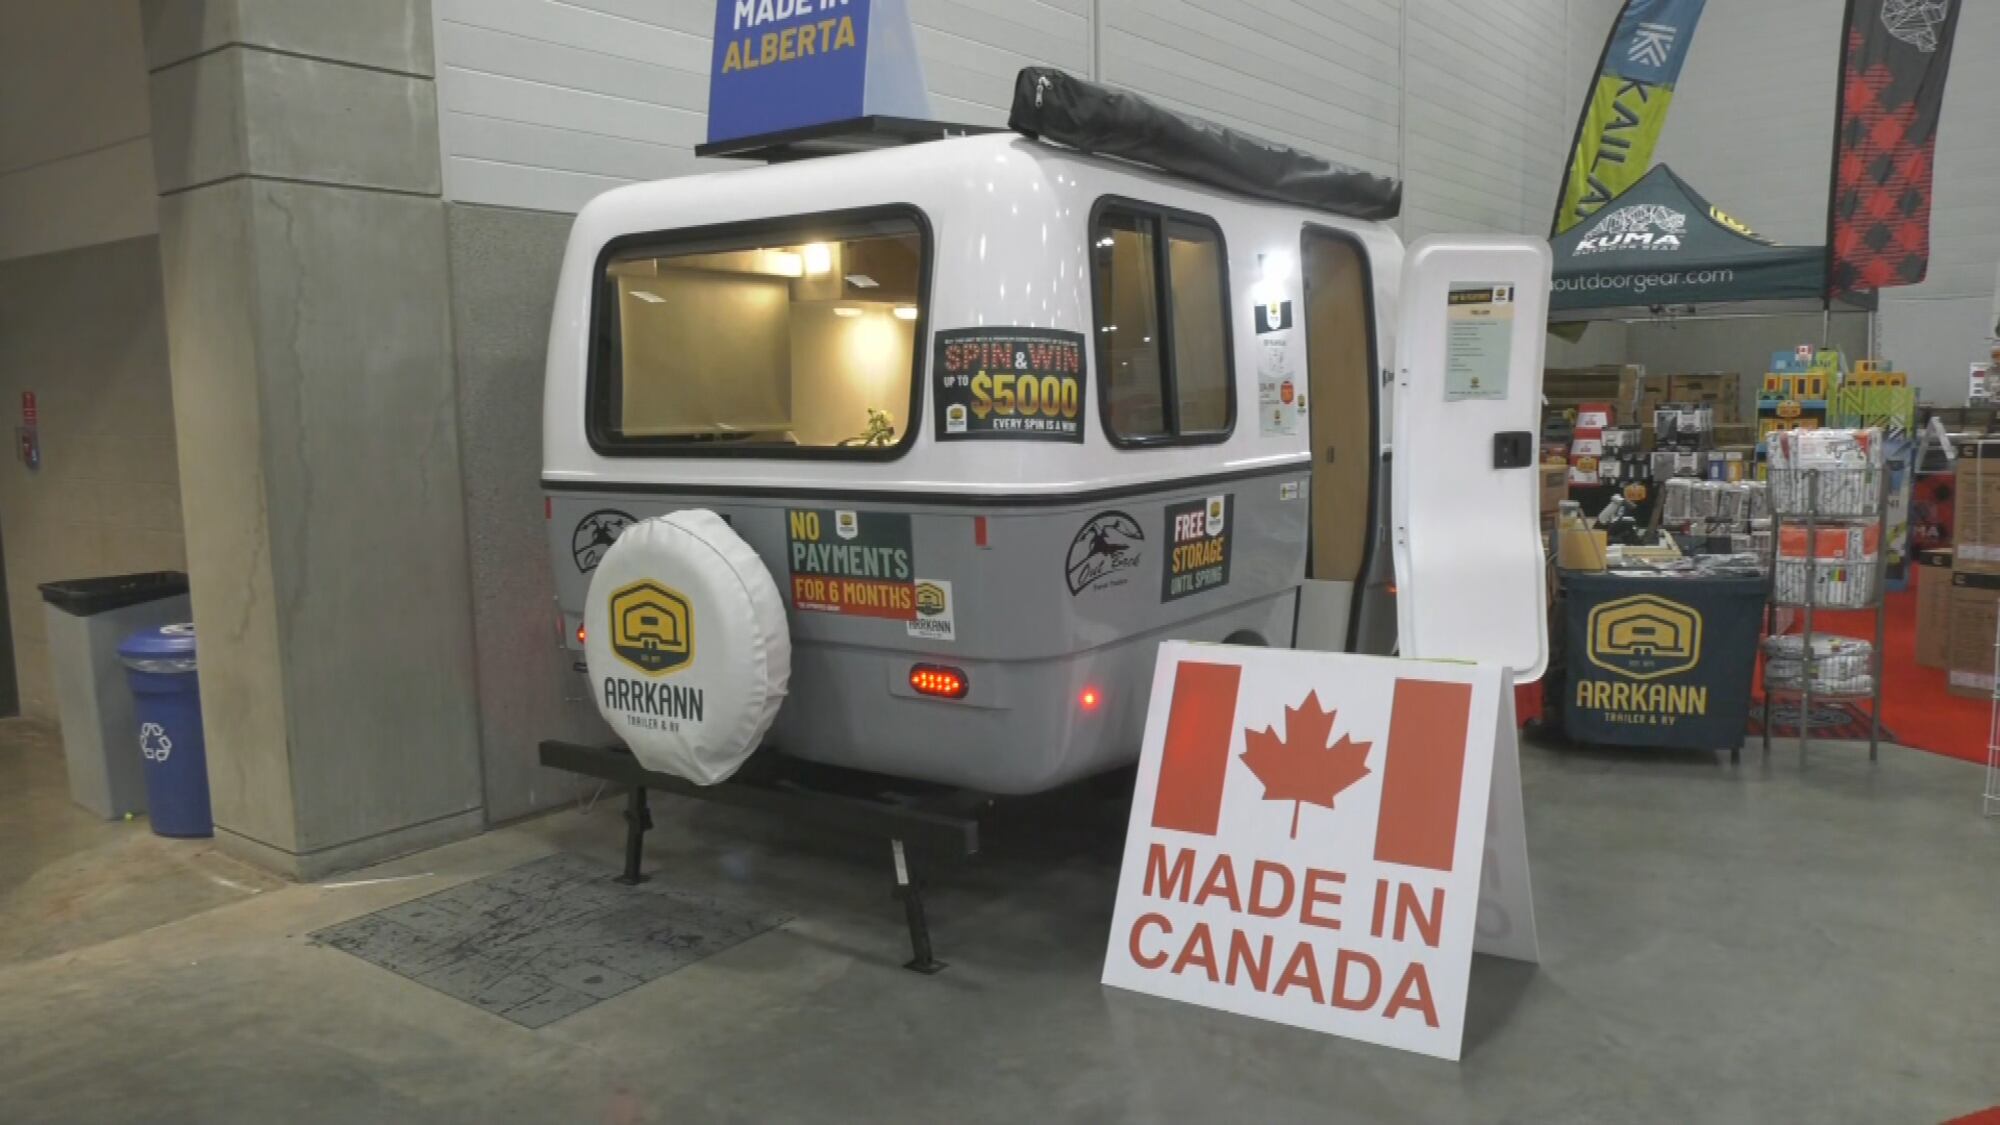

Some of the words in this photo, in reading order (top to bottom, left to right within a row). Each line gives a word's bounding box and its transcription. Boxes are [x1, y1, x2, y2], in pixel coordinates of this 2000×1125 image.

[722, 16, 856, 73] ALBERTA
[1575, 76, 1649, 217] KAILA
[1575, 233, 1680, 251] KUMA
[1549, 269, 1734, 293] outdoorgear.com
[945, 343, 1013, 371] SPIN
[1015, 351, 1028, 369] &
[1027, 343, 1078, 374] WIN
[943, 376, 956, 388] UP
[957, 374, 969, 387] TO
[970, 370, 1077, 420] $5000
[993, 418, 1022, 429] EVERY
[1024, 419, 1045, 431] SPIN
[1046, 420, 1054, 430] IS
[790, 511, 820, 540] NO
[1175, 511, 1205, 543] FREE
[792, 543, 909, 579] PAYMENTS
[1172, 536, 1225, 576] STORAGE
[795, 578, 825, 601] FOR
[829, 581, 840, 604] 6
[843, 582, 911, 610] MONTHS
[604, 676, 704, 722] ARRKANN
[1576, 680, 1707, 716] ARRKANN
[627, 714, 659, 730] TRAILER
[1604, 711, 1646, 724] TRAILER
[1142, 843, 1347, 930] MADE
[1370, 878, 1446, 949] IN
[1128, 912, 1440, 1028] CANADA
